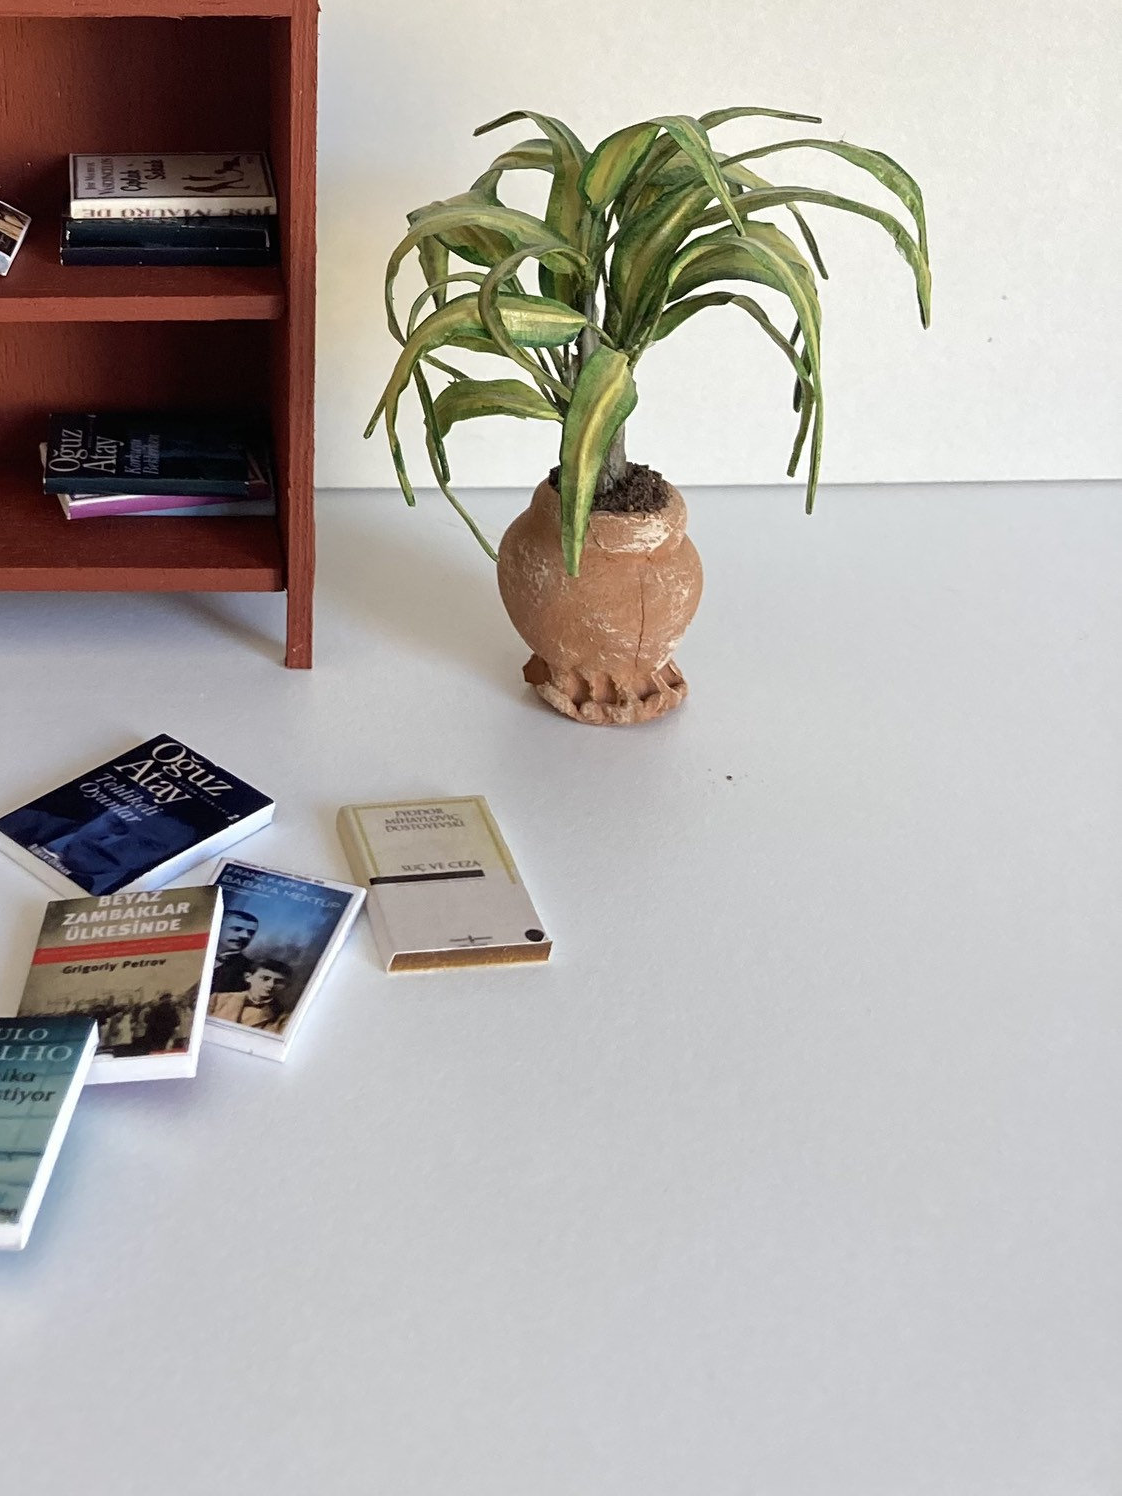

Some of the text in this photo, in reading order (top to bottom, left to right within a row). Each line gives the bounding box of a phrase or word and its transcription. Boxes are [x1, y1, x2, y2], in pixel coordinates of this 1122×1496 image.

[48, 429, 87, 473] Oğuz
[82, 435, 125, 474] Atay
[113, 759, 192, 804] Atay
[152, 742, 233, 796] Oğuz
[79, 782, 142, 822] Oyunlar
[95, 773, 164, 816] Tehlikeli
[448, 860, 482, 869] CEZA
[61, 902, 191, 926] ZAMBAKLAR
[98, 891, 163, 907] BEYAZ
[65, 918, 182, 941] ÜLKESİNDE
[62, 958, 167, 974] Grigoriy Petrov
